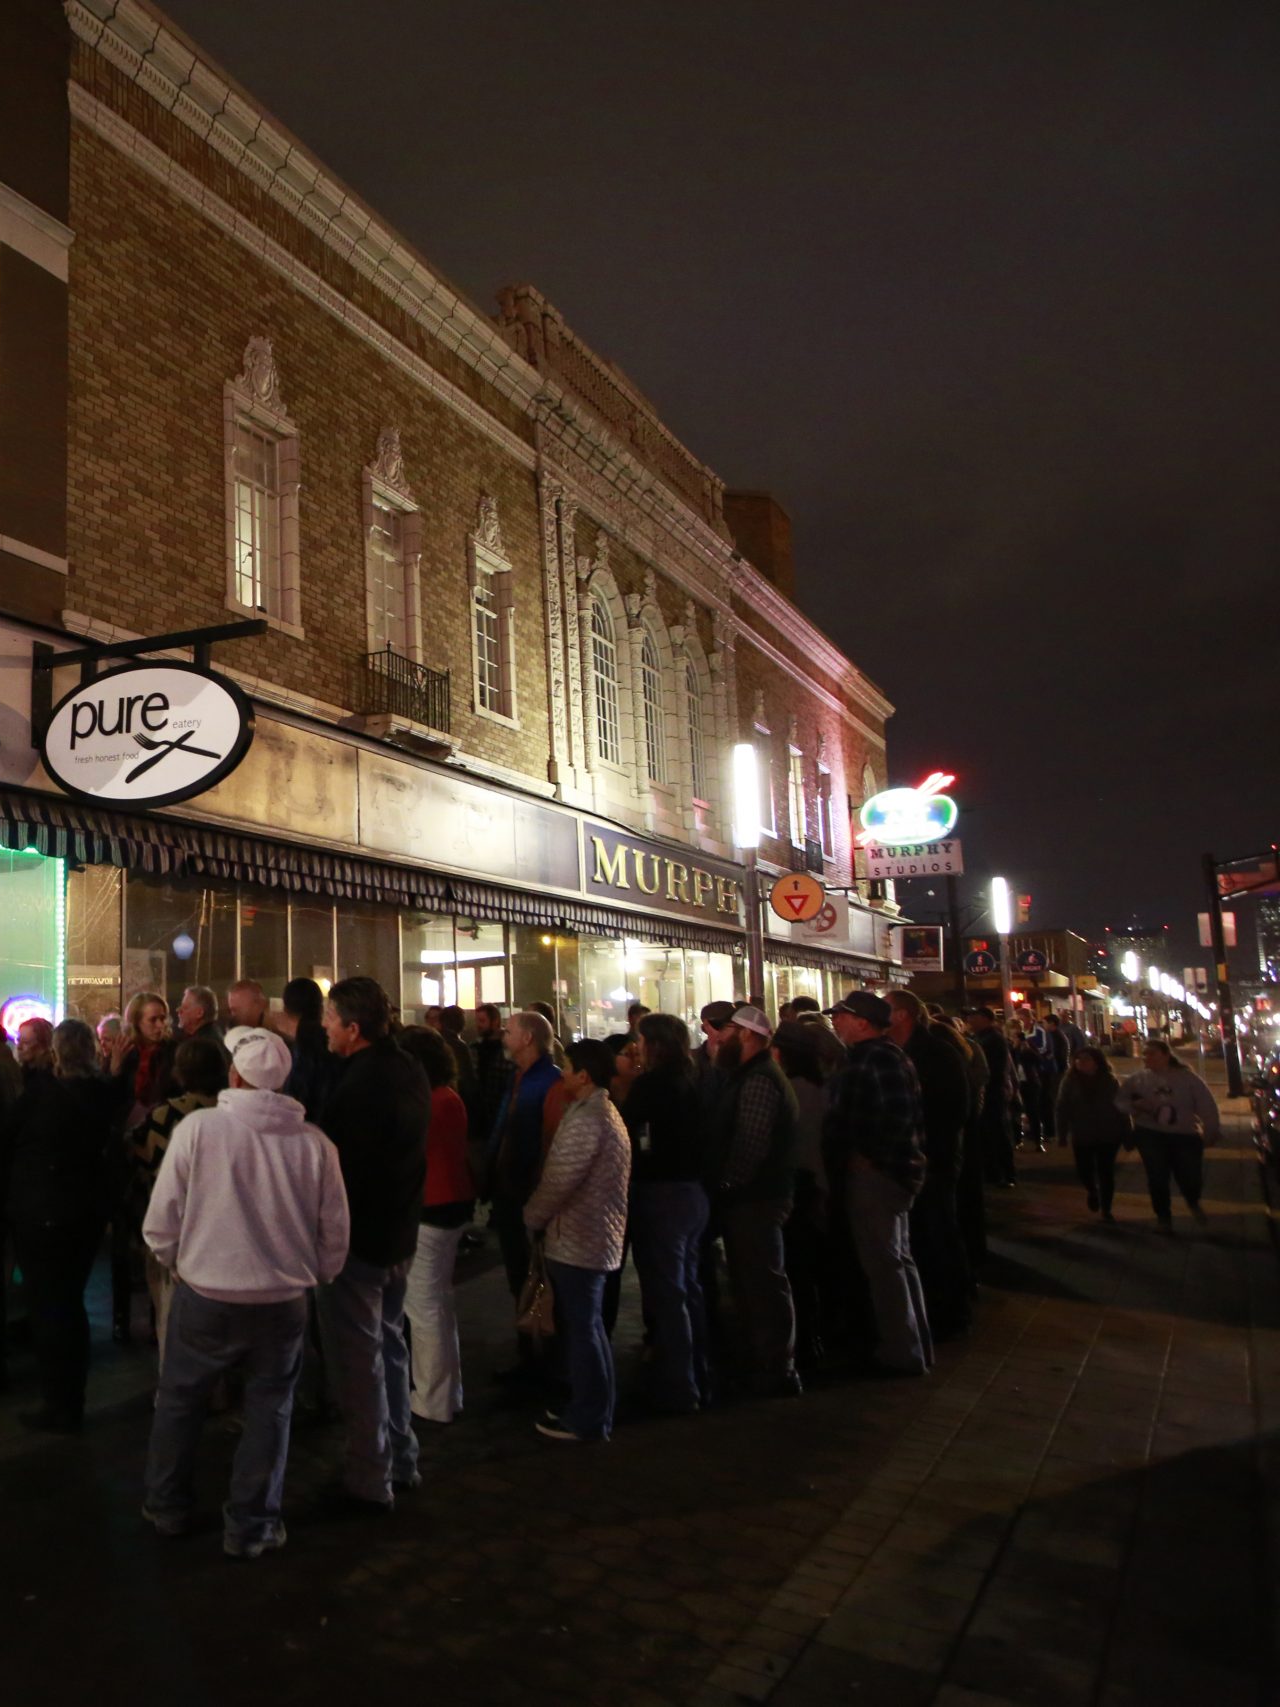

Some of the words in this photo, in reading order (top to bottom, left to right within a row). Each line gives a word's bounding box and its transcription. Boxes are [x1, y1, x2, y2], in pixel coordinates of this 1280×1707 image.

[70, 692, 170, 750] pure
[172, 719, 202, 729] eatery
[75, 755, 93, 764] fresh
[95, 754, 120, 762] honest
[122, 752, 139, 760] food
[870, 842, 953, 859] MURPHY
[591, 836, 745, 915] MURPH
[874, 862, 952, 876] STUDIOS
